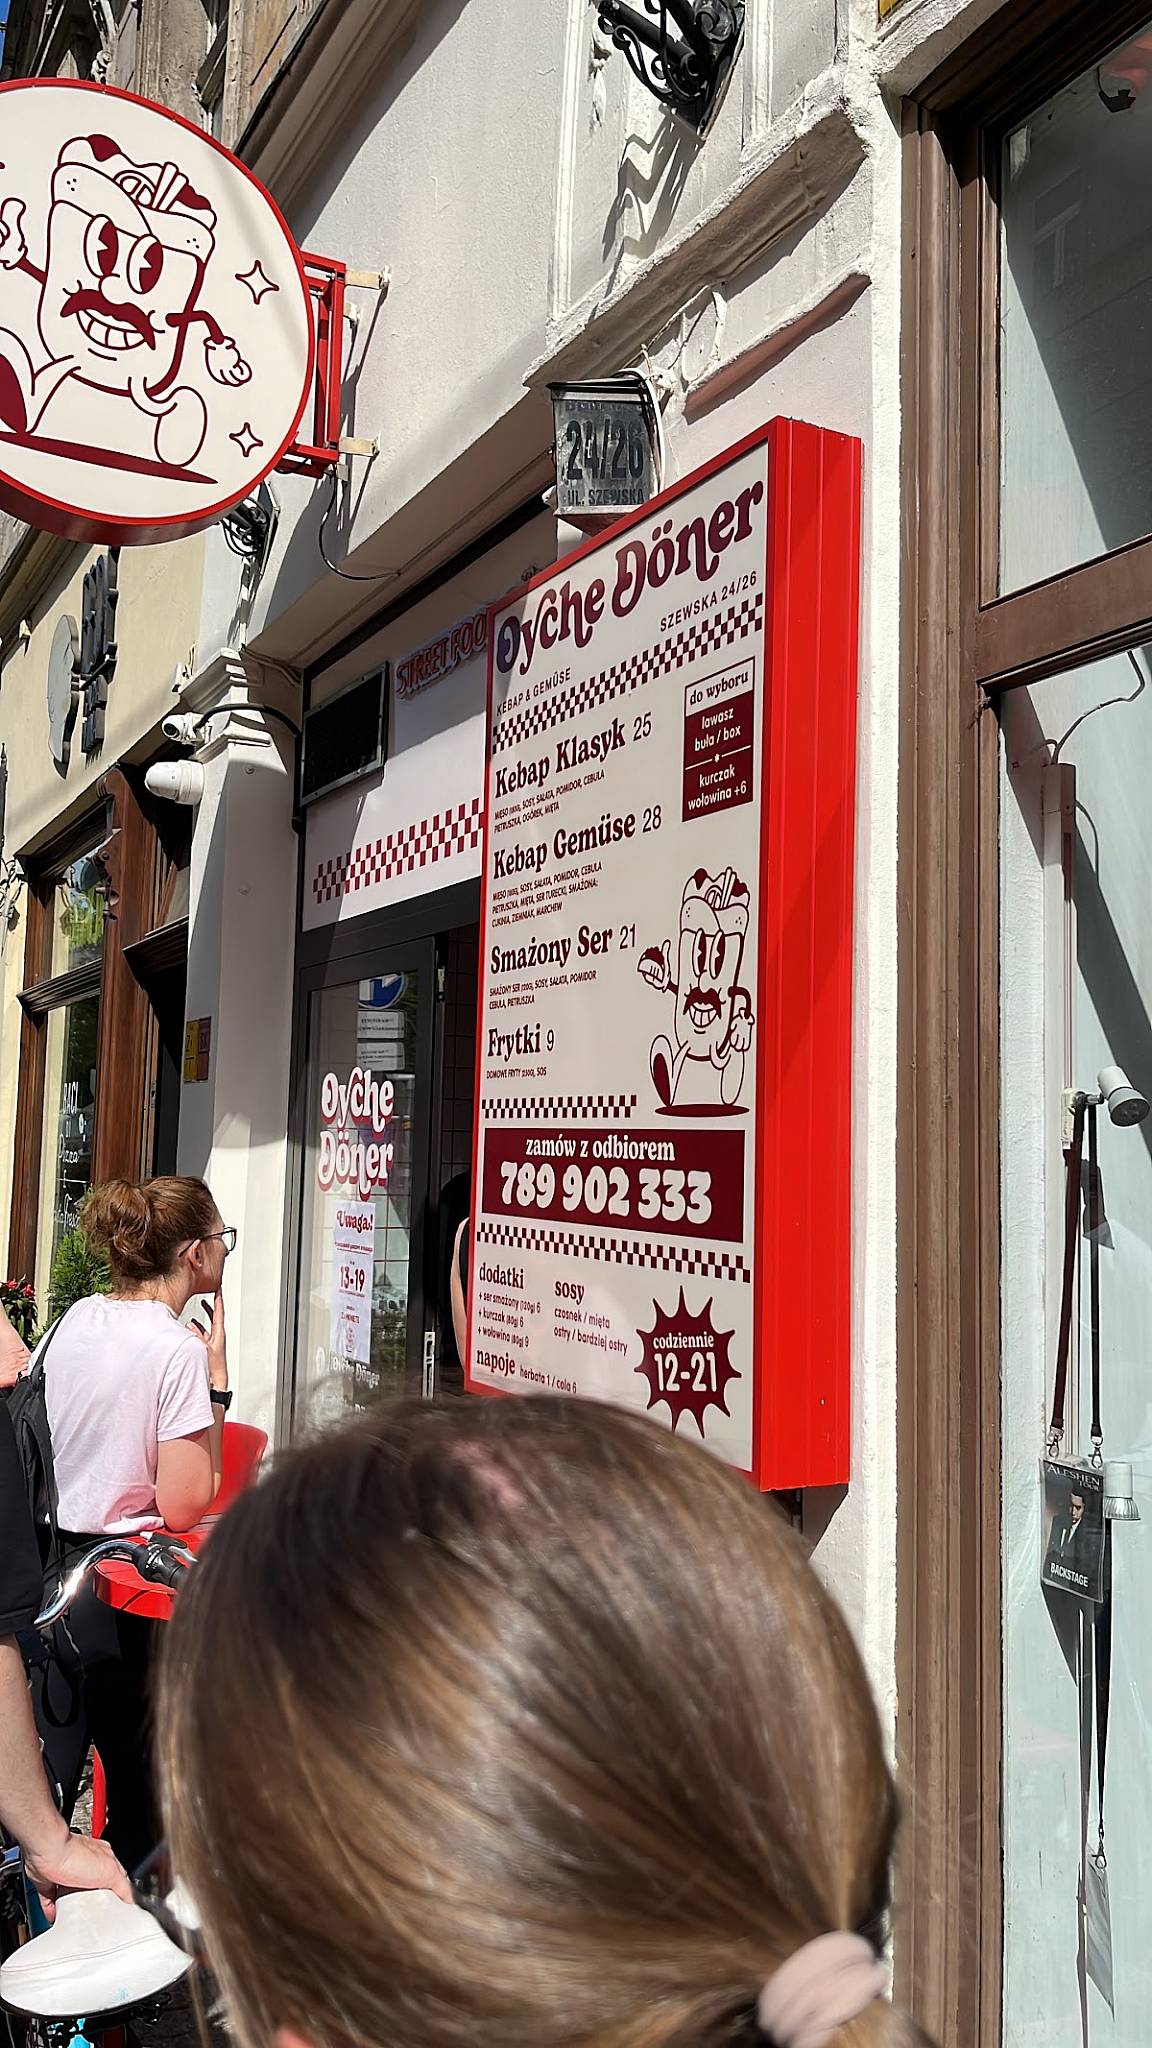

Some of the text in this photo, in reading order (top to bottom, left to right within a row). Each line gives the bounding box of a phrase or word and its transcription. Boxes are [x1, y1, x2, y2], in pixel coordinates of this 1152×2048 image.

[567, 419, 643, 479] 24/26
[589, 488, 644, 505] SZEWSKA
[612, 481, 763, 618] Döner
[660, 571, 757, 632] SZEWSKA 24/26
[396, 614, 487, 696] STREET FOO
[497, 667, 570, 717] KEBAP & GEMÜSE
[690, 671, 749, 705] do wyboru
[701, 708, 734, 729] lawasz
[694, 734, 714, 752] buła
[723, 725, 741, 741] box
[495, 712, 652, 798] Kebap Klasyk 25
[556, 778, 582, 797] POMIDOR,
[583, 769, 605, 786] CEBULA
[699, 764, 736, 788] kurczak
[688, 780, 747, 810] wołowina +6
[522, 807, 544, 823] OGÓREK,
[545, 801, 560, 814] MIĘTA
[493, 804, 662, 879] Kebap Gemüse 28
[553, 868, 580, 884] POMIDOR,
[536, 892, 545, 903] SER
[536, 901, 563, 916] MARCHEW
[490, 923, 636, 974] Smażony Ser 21
[489, 984, 511, 997] SMAŻONY
[512, 983, 520, 993] SER
[569, 970, 597, 984] POMIDOR
[507, 995, 535, 1007] PIETRUSZKA
[487, 1023, 555, 1062] Frytki 9
[486, 1069, 507, 1079] DOMOWE
[536, 1066, 547, 1076] SOS
[526, 1134, 675, 1161] zamów z odbiorem
[318, 1130, 394, 1197] Döner
[500, 1161, 712, 1224] 789 902 333
[337, 1210, 373, 1233] Uwaga!
[340, 1265, 365, 1292] 13-19
[479, 1262, 524, 1289] dodatki
[483, 1292, 492, 1301] ser
[493, 1294, 519, 1311] smażony
[536, 1302, 541, 1314] 6
[554, 1280, 585, 1305] sosy
[483, 1307, 505, 1323] kurczak
[519, 1316, 524, 1328] 6
[554, 1307, 582, 1322] czosnek
[588, 1316, 610, 1329] mięta
[482, 1326, 510, 1343] wołowina
[524, 1335, 529, 1348] 9
[554, 1325, 571, 1342] ostry
[577, 1329, 607, 1351] bardziej
[609, 1339, 628, 1356] ostry
[653, 1331, 715, 1350] codziennie
[476, 1349, 515, 1377] napoje
[520, 1364, 545, 1384] herbata
[546, 1374, 550, 1386] 1
[556, 1378, 571, 1392] cola
[572, 1382, 577, 1394] 6
[654, 1351, 718, 1393] 12-21
[1047, 1464, 1100, 1486] ALESHEN
[1050, 1562, 1089, 1588] BACKSTAGE
